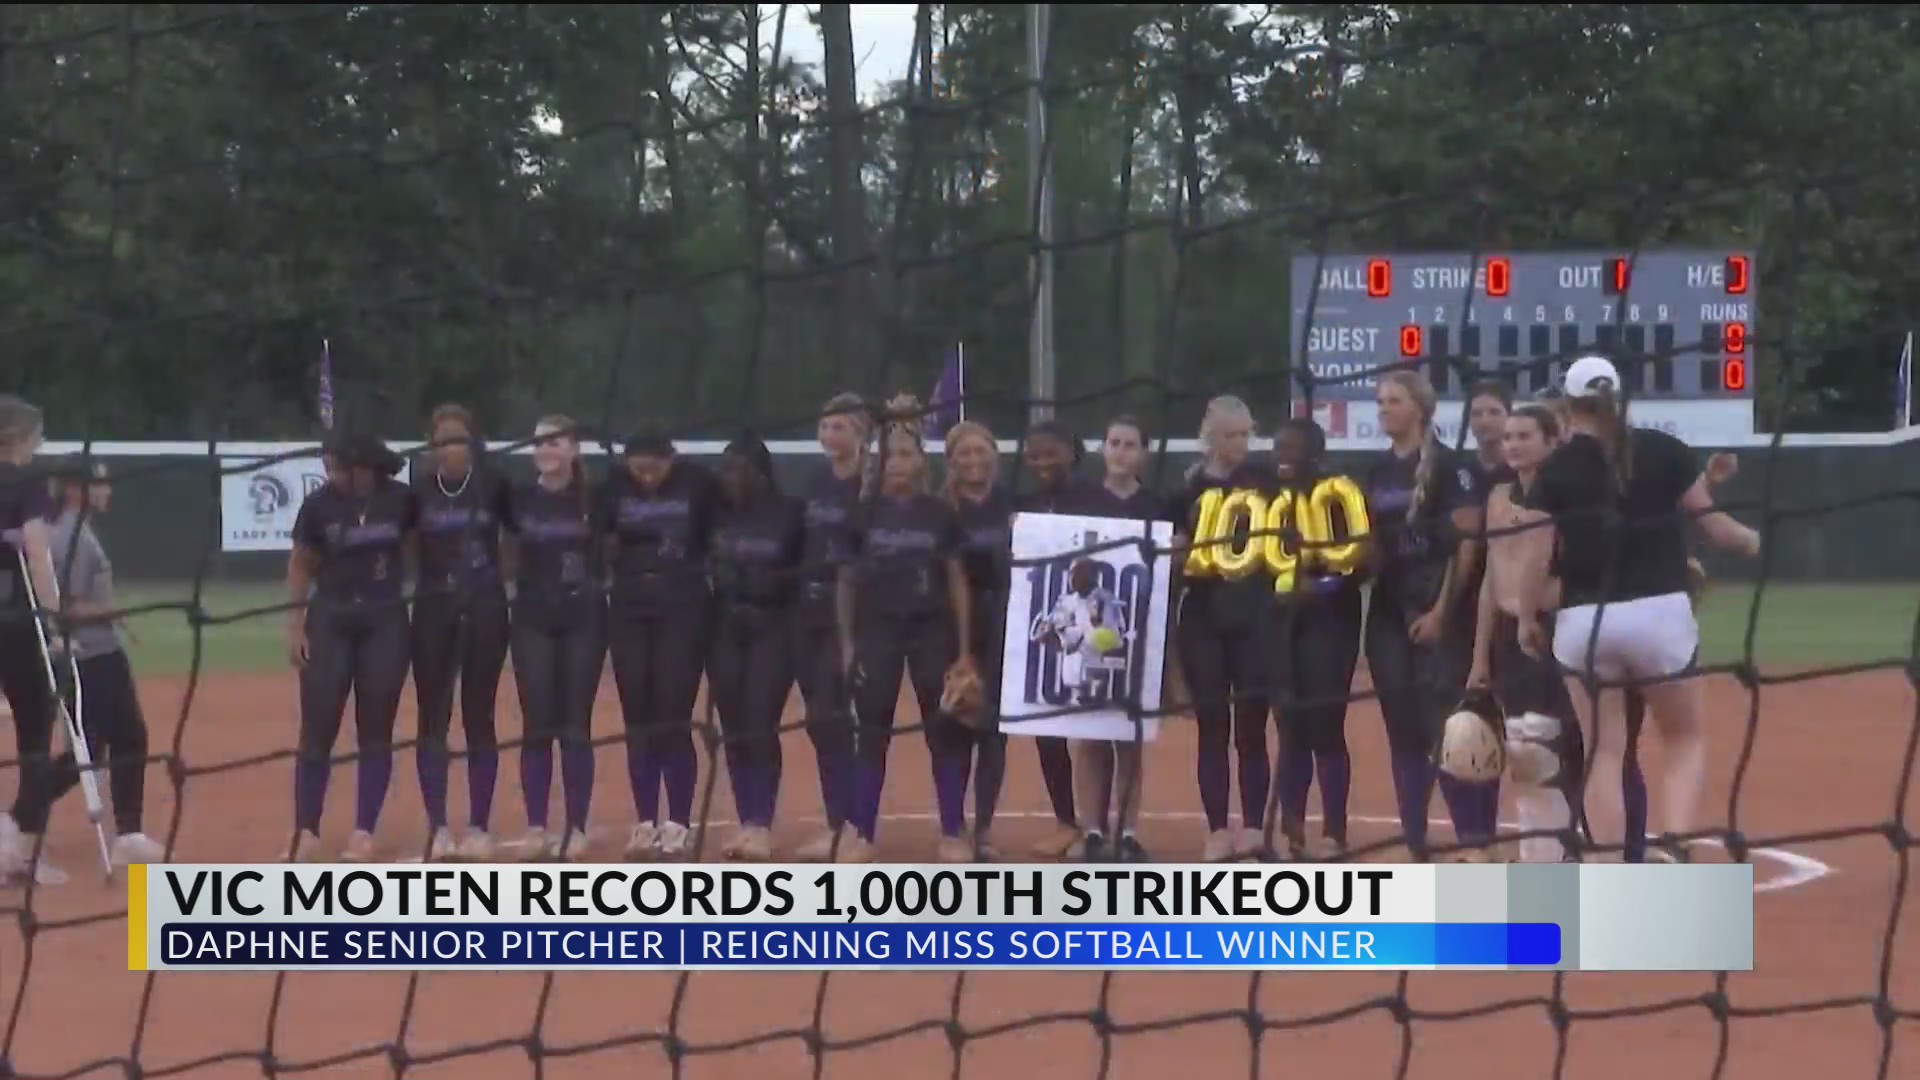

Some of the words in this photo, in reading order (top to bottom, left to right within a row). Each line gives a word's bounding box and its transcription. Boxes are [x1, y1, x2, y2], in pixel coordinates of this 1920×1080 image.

[1559, 266, 1601, 288] OUT
[1687, 265, 1724, 287] H/E
[1435, 306, 1446, 323] 2
[1503, 306, 1513, 322] 4
[1535, 305, 1545, 322] 5
[1564, 304, 1575, 322] 6
[1602, 305, 1612, 321] 7
[1630, 304, 1640, 321] 8
[1657, 304, 1668, 321] 9
[1701, 303, 1749, 321] RUNS
[1309, 327, 1380, 352] GUEST
[1726, 359, 1744, 390] 0
